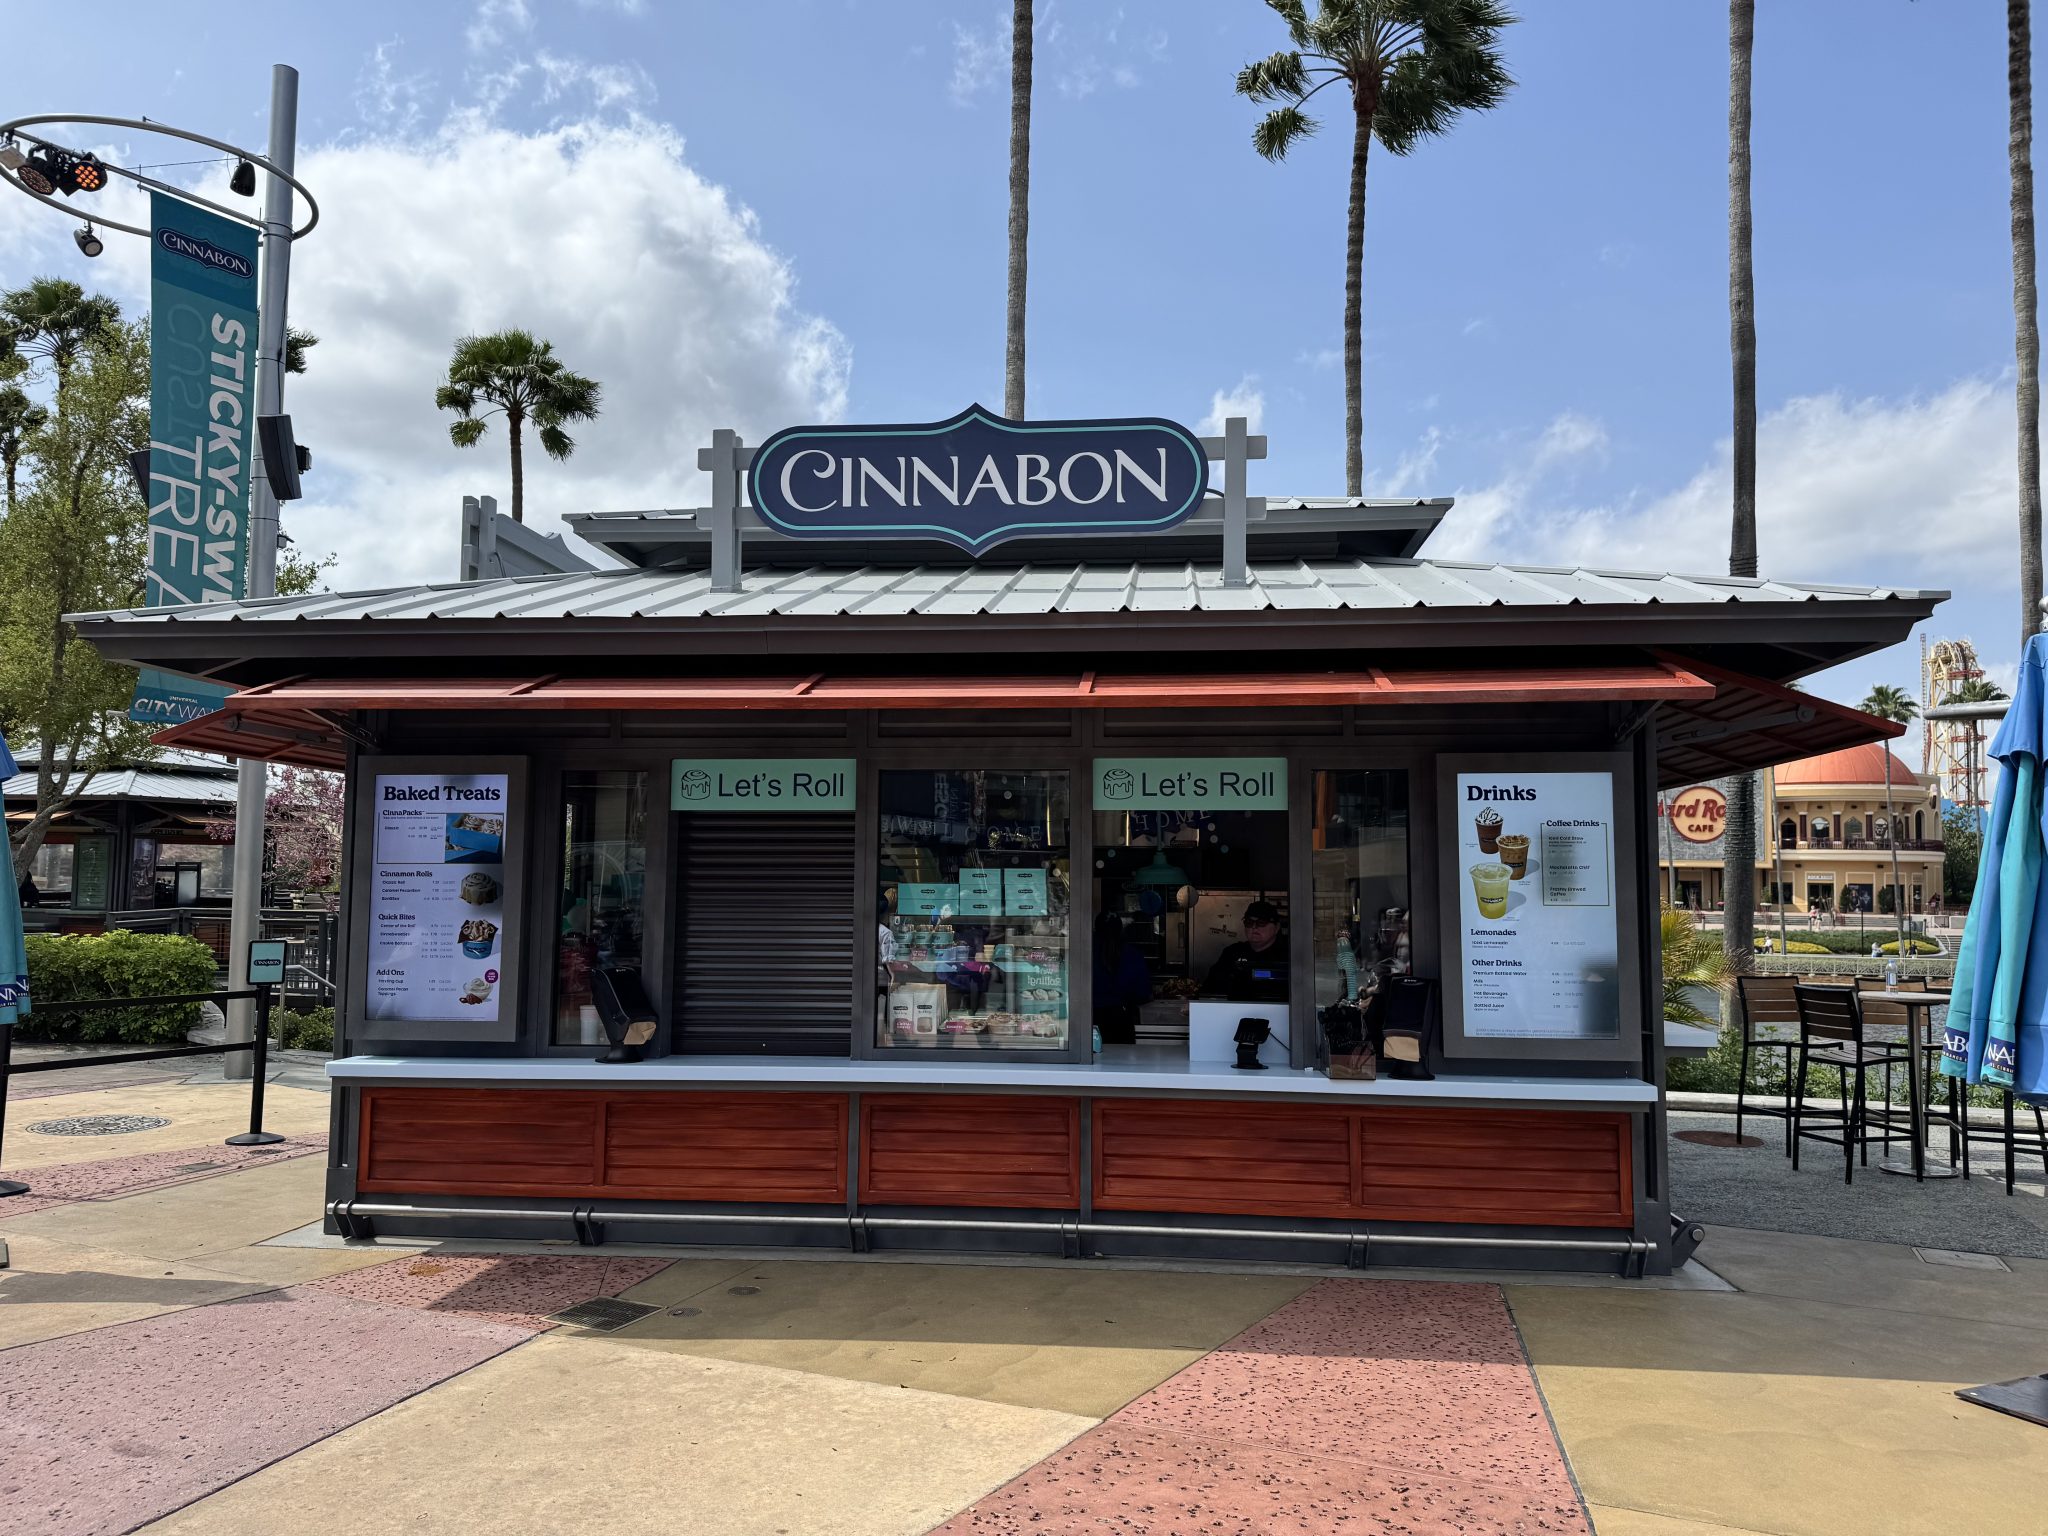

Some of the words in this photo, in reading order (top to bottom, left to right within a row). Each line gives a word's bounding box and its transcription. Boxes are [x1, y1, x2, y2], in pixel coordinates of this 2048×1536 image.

[163, 232, 248, 274] CINNABON
[780, 446, 1168, 512] CINNABON
[384, 785, 439, 801] Baked
[443, 785, 501, 801] Treats
[718, 773, 782, 798] Let's
[793, 773, 844, 798] Roll
[1141, 772, 1208, 798] Let's
[1219, 772, 1275, 798] Roll
[1466, 785, 1537, 802] Drinks
[1687, 824, 1715, 833] CAFE
[378, 913, 398, 921] Quick
[399, 913, 416, 921] Bites
[1470, 928, 1517, 936] Lemonades
[1471, 959, 1495, 967] Other
[1495, 959, 1523, 967] Drinks
